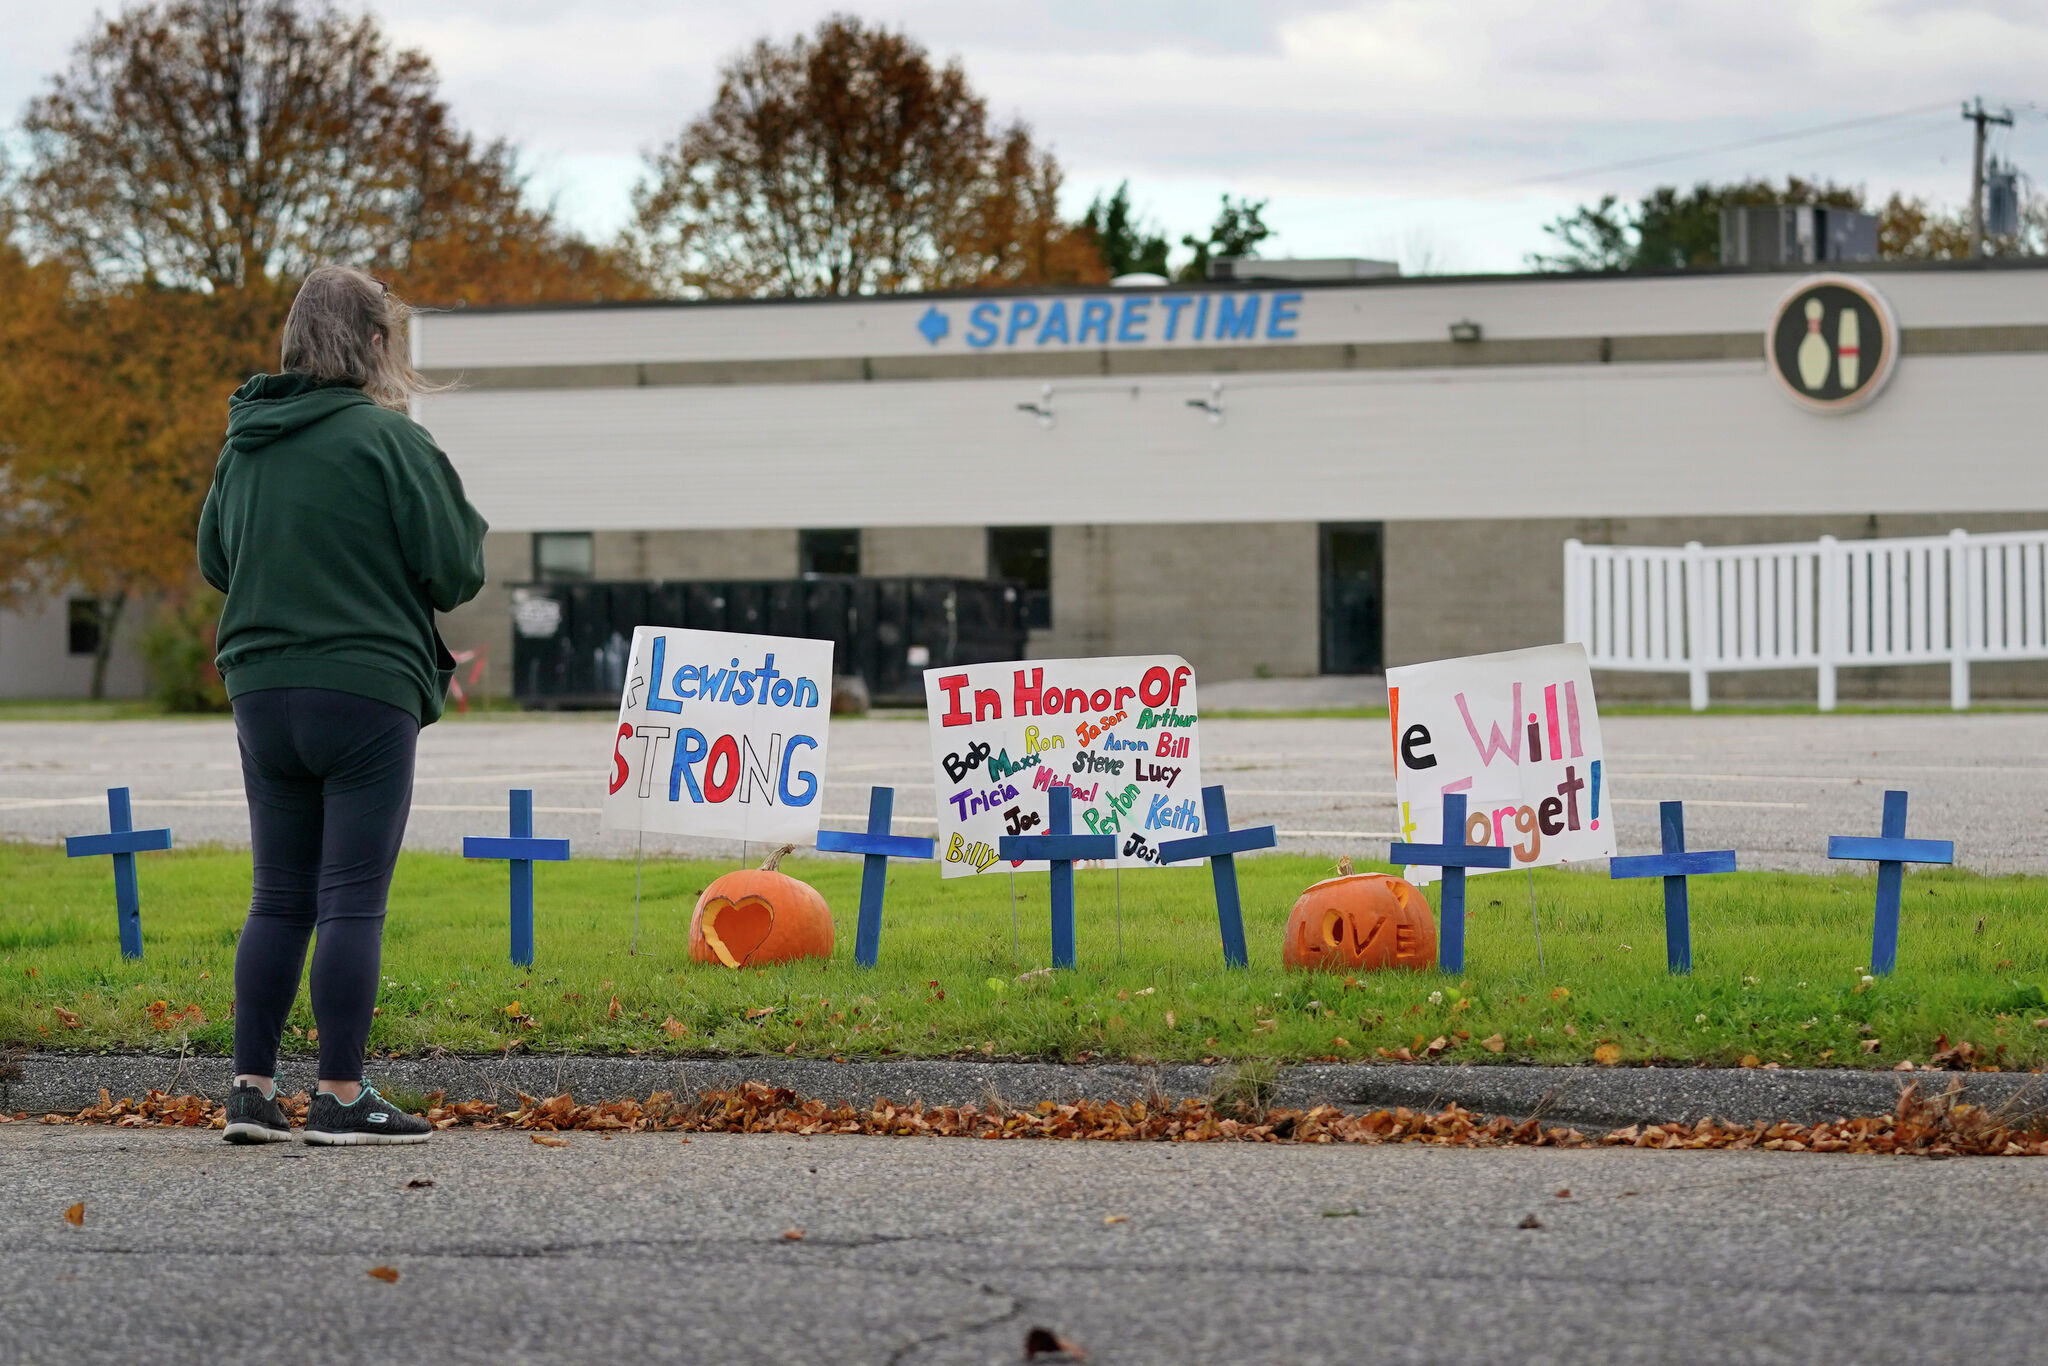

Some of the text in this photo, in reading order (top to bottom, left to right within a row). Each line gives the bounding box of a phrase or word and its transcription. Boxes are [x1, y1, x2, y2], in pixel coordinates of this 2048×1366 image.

[965, 294, 1303, 348] SPARETIME
[646, 635, 819, 714] Lewiston
[938, 665, 1192, 727] In Honor Of
[1076, 711, 1128, 747] Jason
[1136, 708, 1197, 729] Arthur
[1454, 680, 1584, 767] Will
[1025, 725, 1065, 754] Ron
[1104, 732, 1149, 751] Aaron
[1155, 732, 1190, 758] Bill
[609, 722, 819, 807] STRONG
[942, 741, 991, 784] Bob
[988, 748, 1041, 783] Maxx
[1072, 750, 1125, 775] Steve
[1136, 758, 1181, 788] Lucy
[949, 784, 1020, 822] Tricia
[1003, 805, 1041, 835] Joe
[1082, 783, 1141, 835] Peyton
[1144, 793, 1200, 833] Keith
[945, 832, 1000, 873] Billy
[1298, 908, 1416, 958] LOVE
